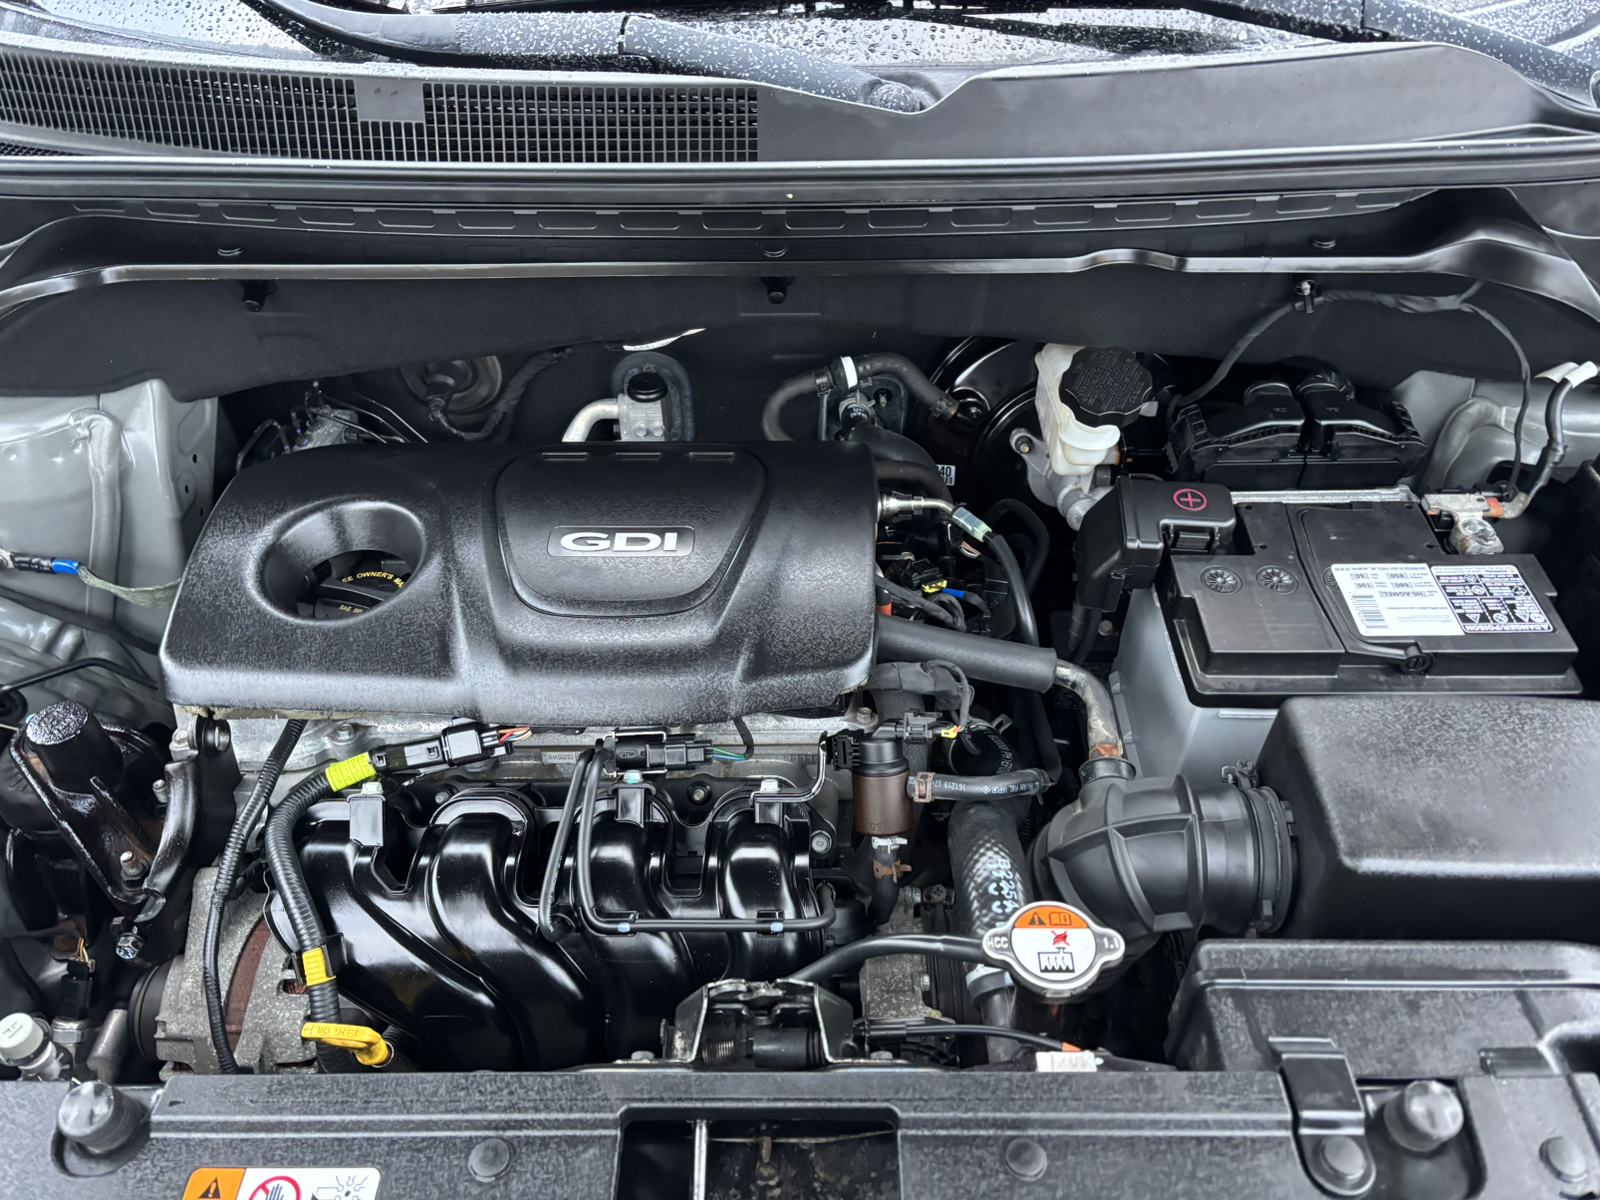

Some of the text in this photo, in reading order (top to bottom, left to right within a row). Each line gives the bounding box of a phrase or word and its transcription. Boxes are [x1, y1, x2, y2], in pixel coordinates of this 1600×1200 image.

[936, 466, 951, 477] 40
[560, 532, 678, 552] GDI
[356, 571, 394, 580] OWNER'S
[338, 604, 352, 612] SAE
[944, 781, 966, 791] 161219
[988, 936, 1008, 948] HCC
[1103, 937, 1119, 949] 1.1
[334, 1028, 358, 1038] ENG
